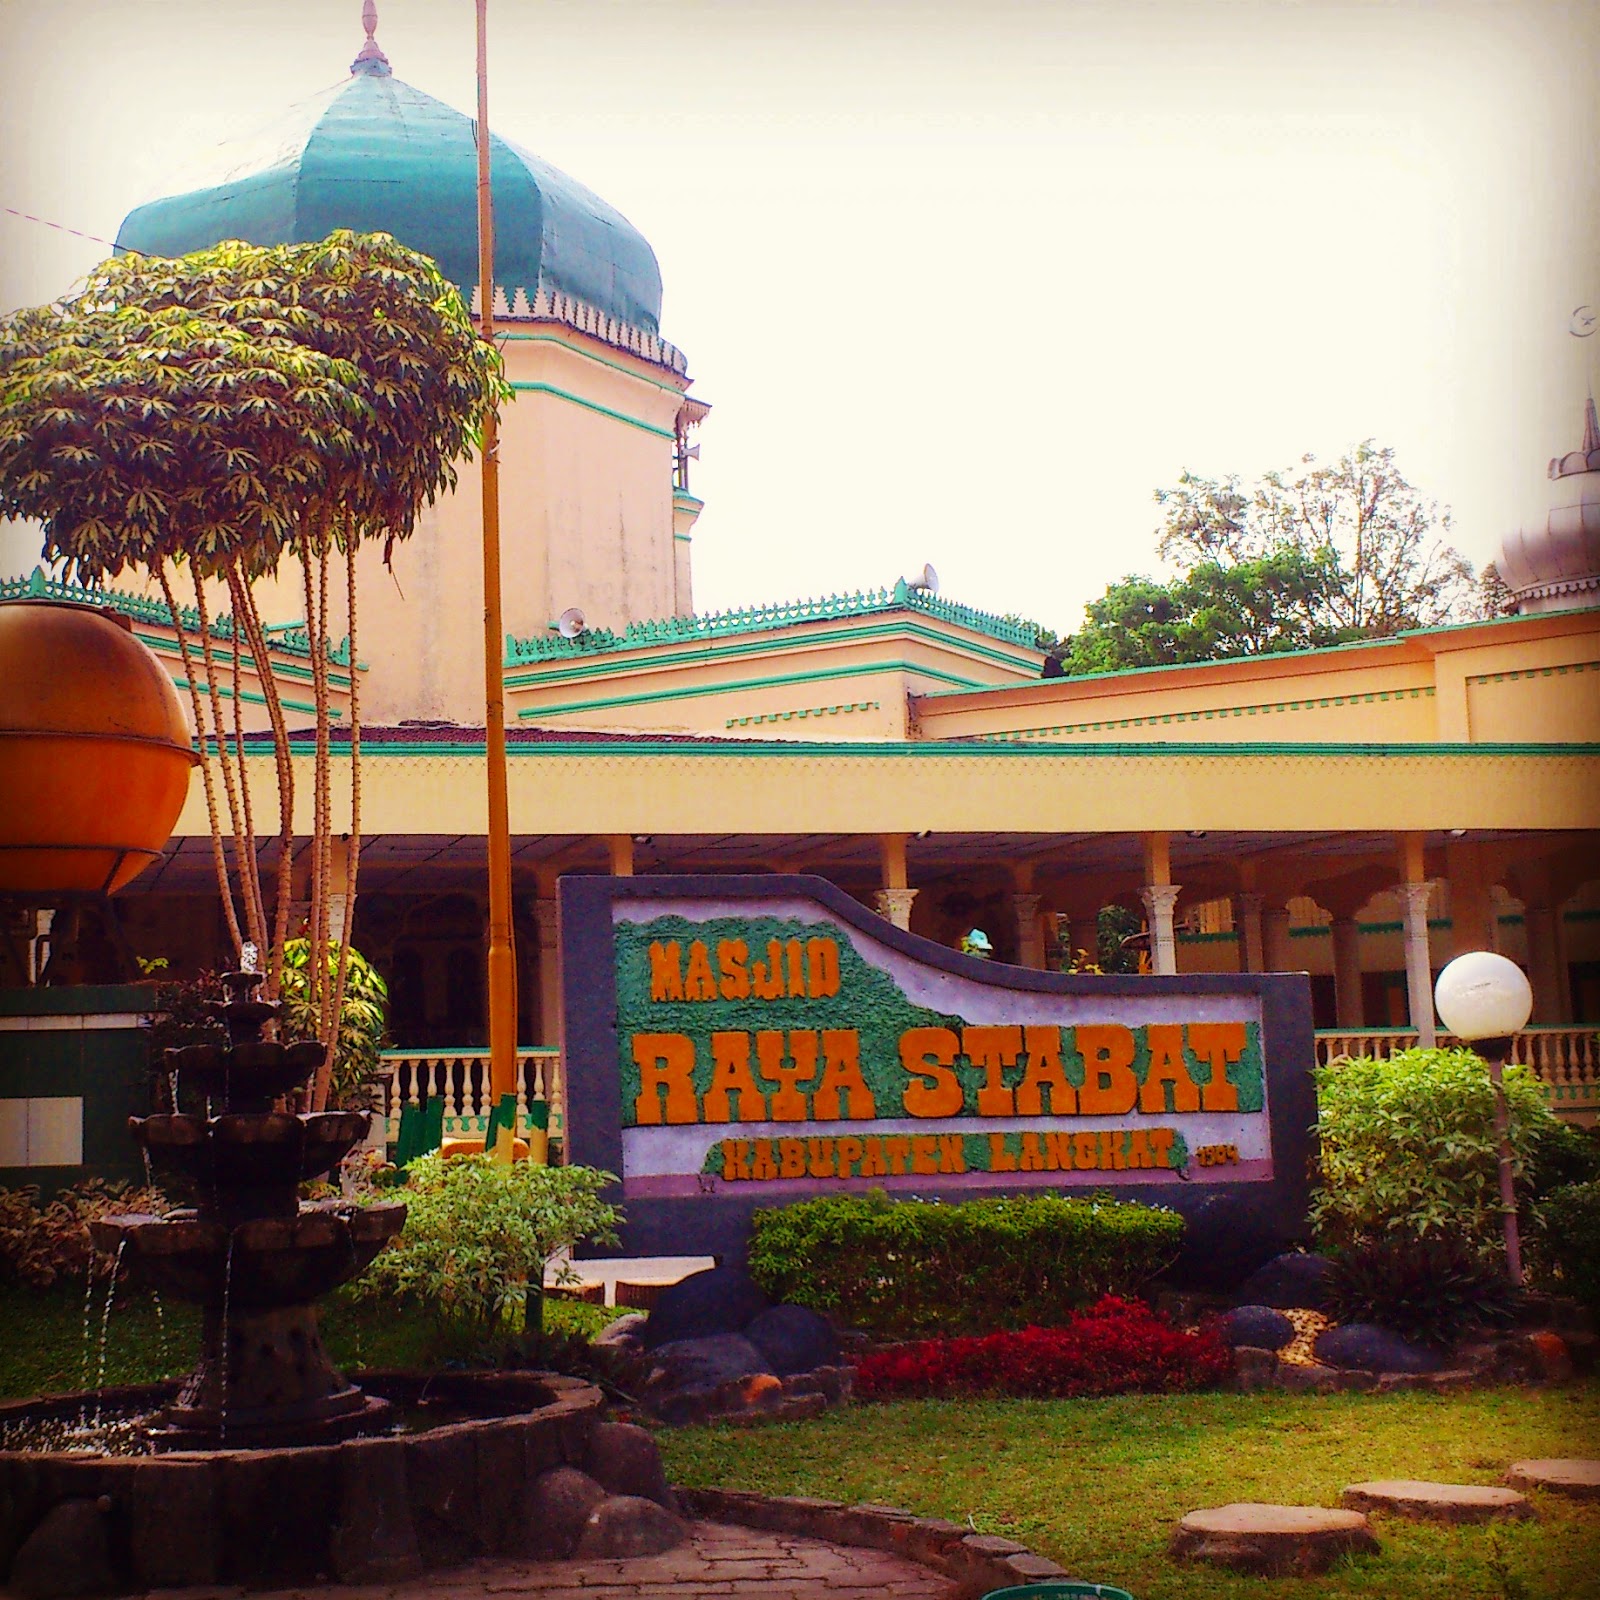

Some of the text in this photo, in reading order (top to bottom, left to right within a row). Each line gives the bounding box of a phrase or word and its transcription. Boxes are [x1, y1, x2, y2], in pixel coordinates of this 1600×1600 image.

[649, 937, 841, 1001] MASJID
[631, 1022, 1247, 1125] RAYA STABAT
[722, 1128, 1175, 1181] KABUPATEN LANGKAT
